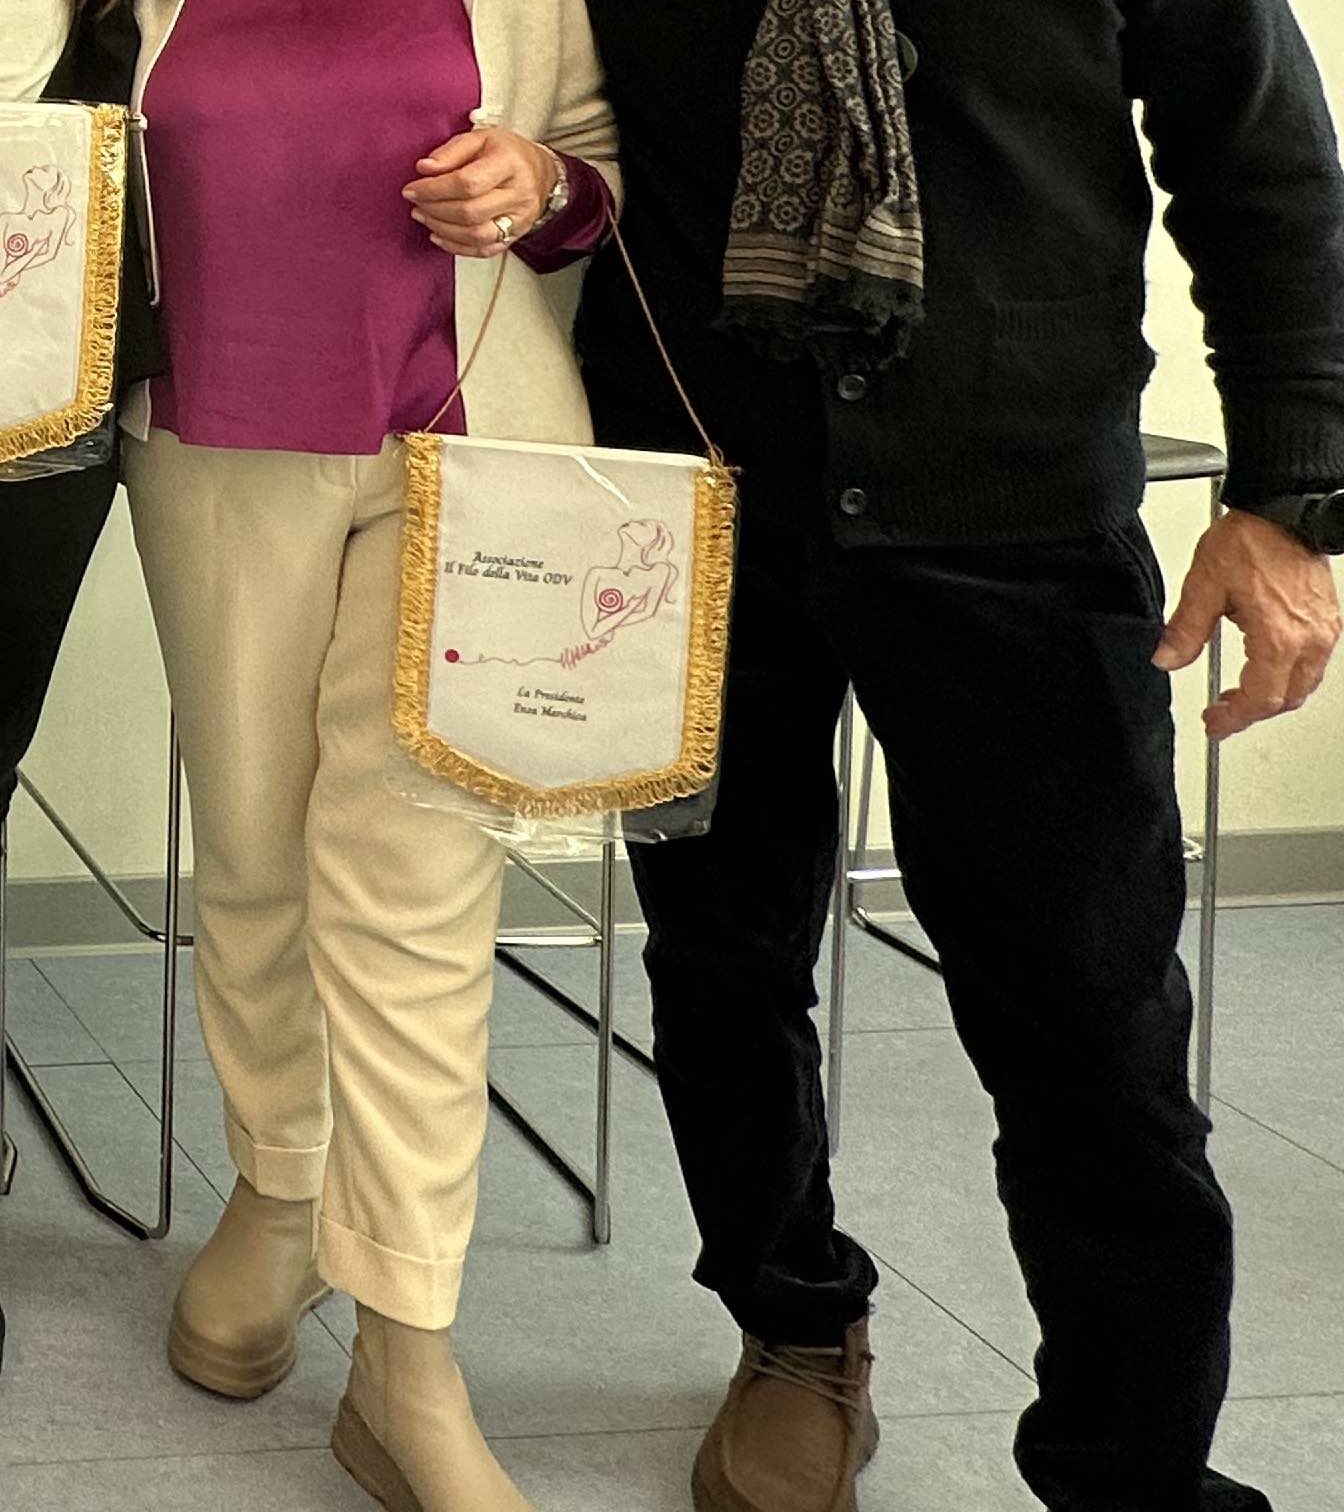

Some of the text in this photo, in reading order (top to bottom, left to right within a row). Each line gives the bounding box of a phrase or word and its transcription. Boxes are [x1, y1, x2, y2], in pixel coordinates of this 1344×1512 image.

[472, 551, 545, 568] Associazione
[444, 561, 574, 586] Il Filo della Vita ODV
